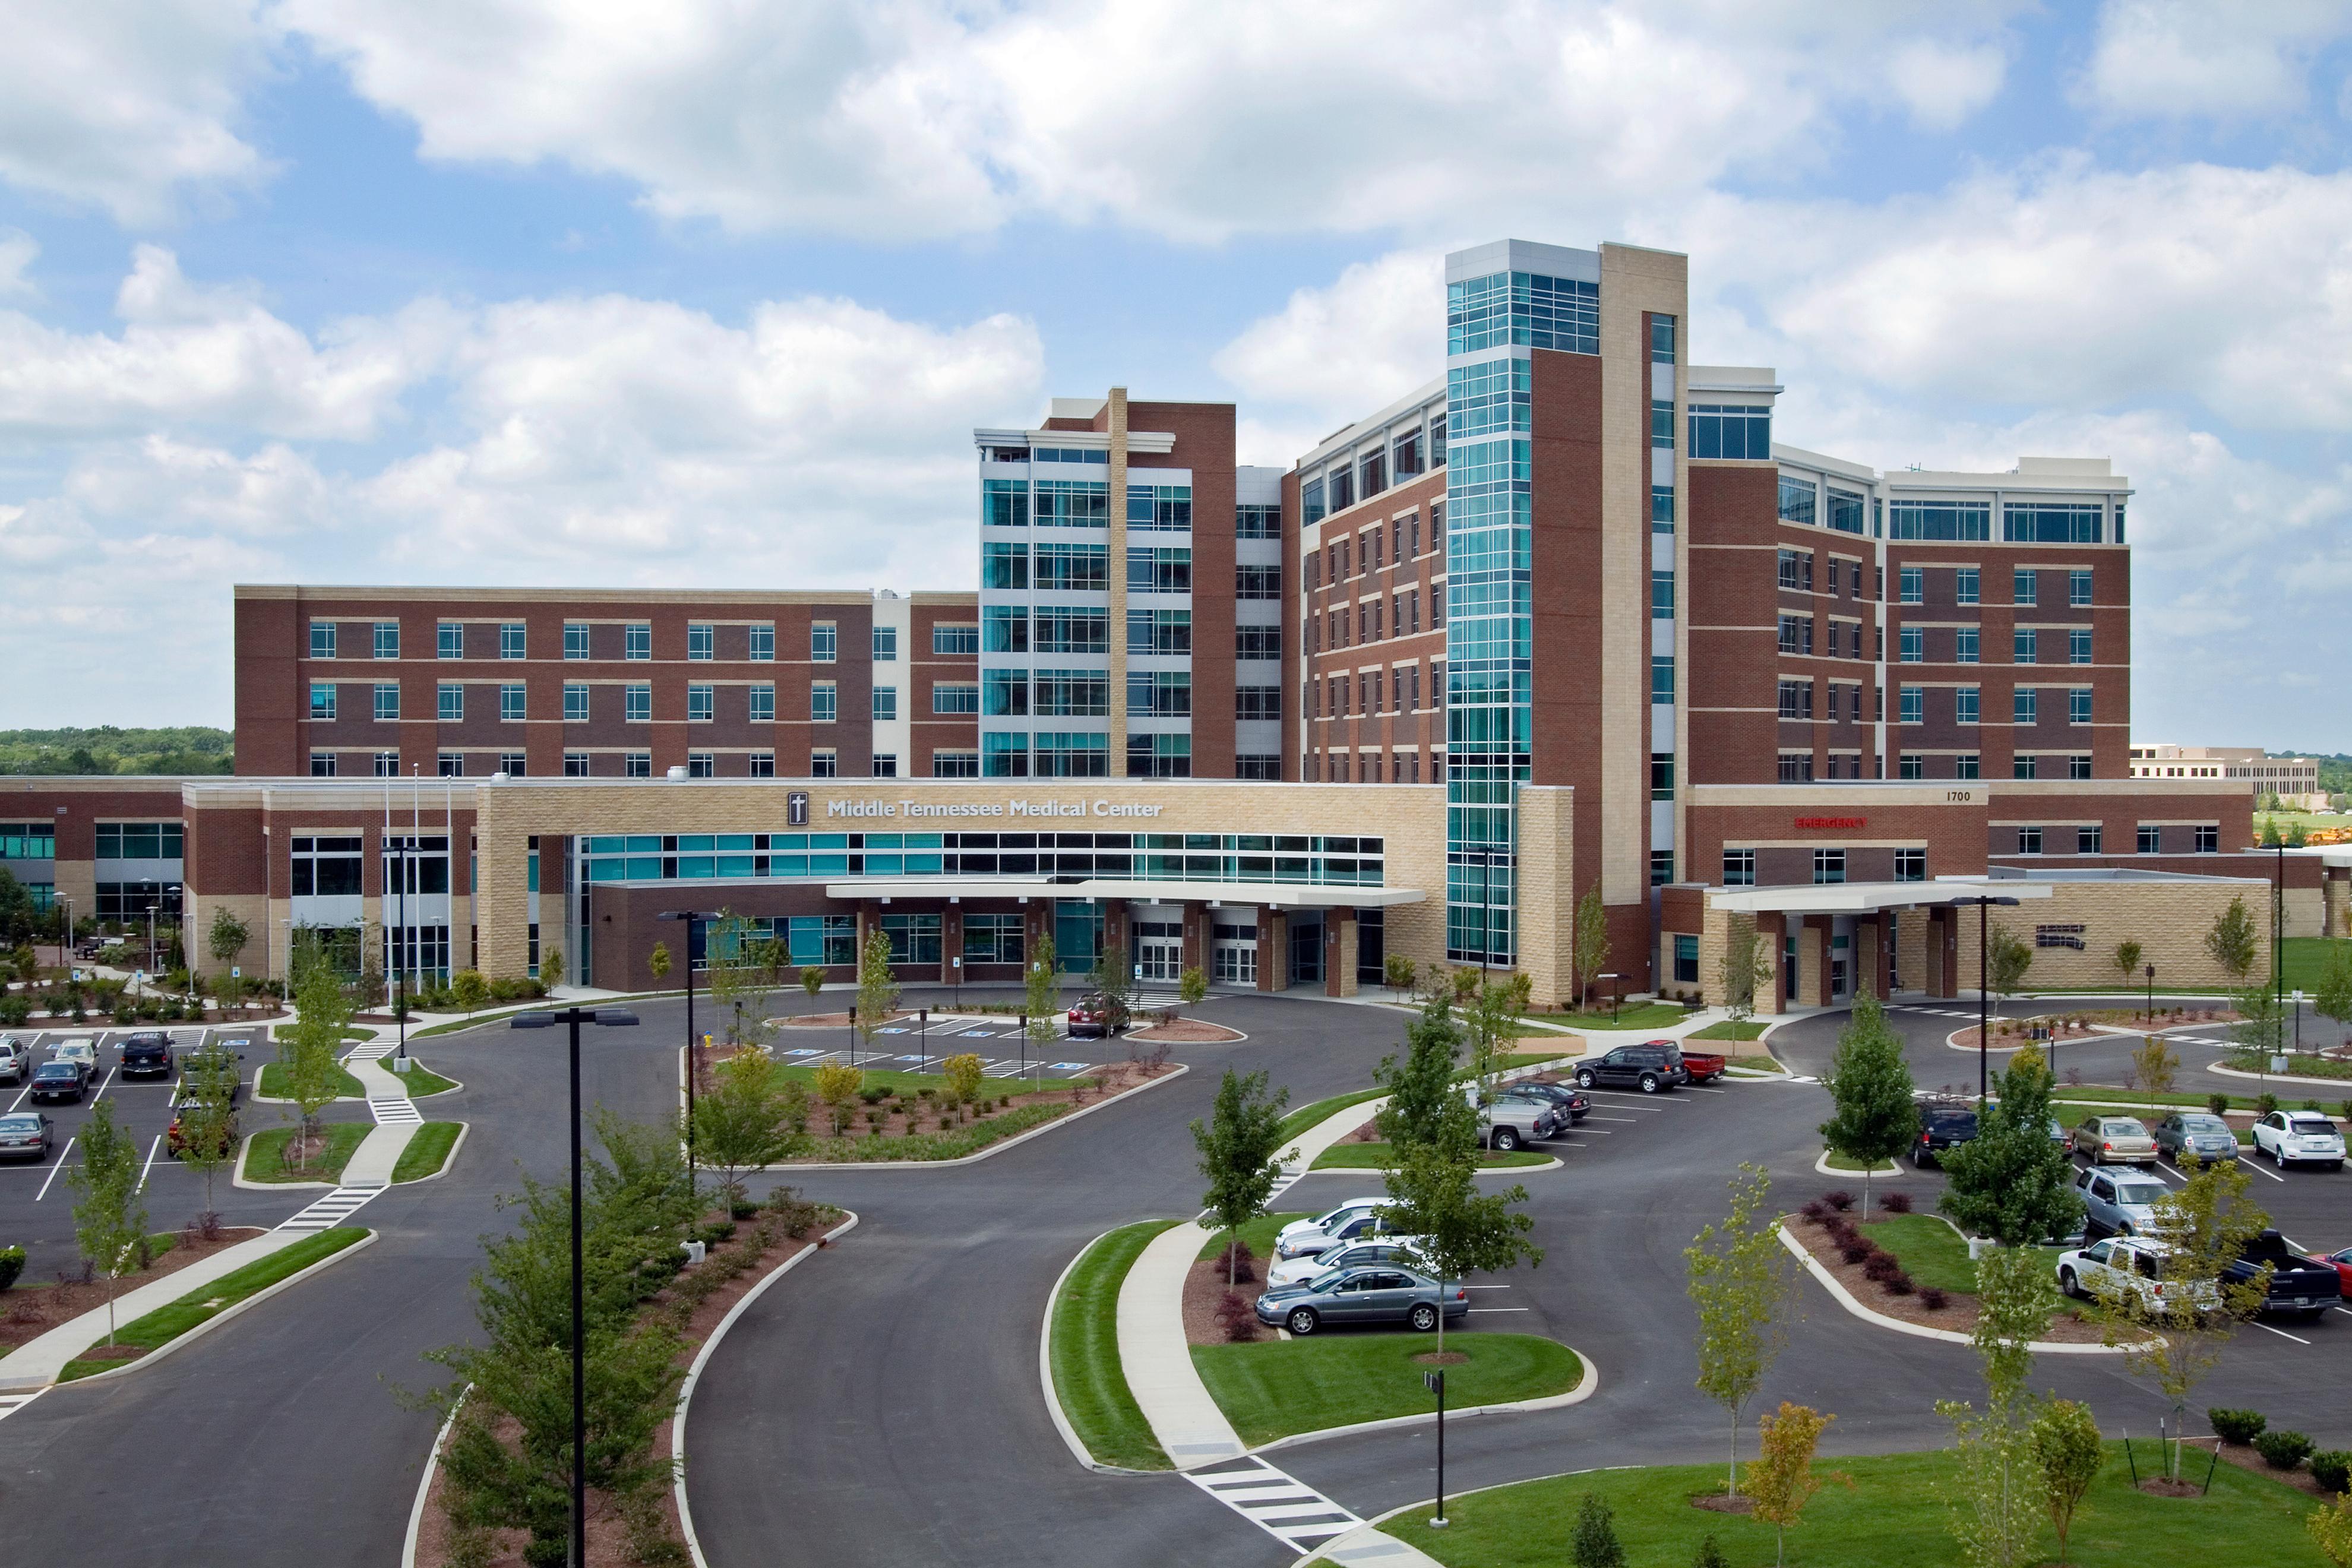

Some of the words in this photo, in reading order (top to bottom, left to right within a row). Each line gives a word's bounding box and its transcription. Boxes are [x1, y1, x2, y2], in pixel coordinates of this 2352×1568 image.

[1947, 792, 1970, 801] 1700
[827, 800, 896, 817] Middle
[899, 800, 1003, 817] Tennessee
[1010, 799, 1086, 817] Medical
[1093, 799, 1164, 817] Center
[1795, 817, 1867, 827] EMERGENCY
